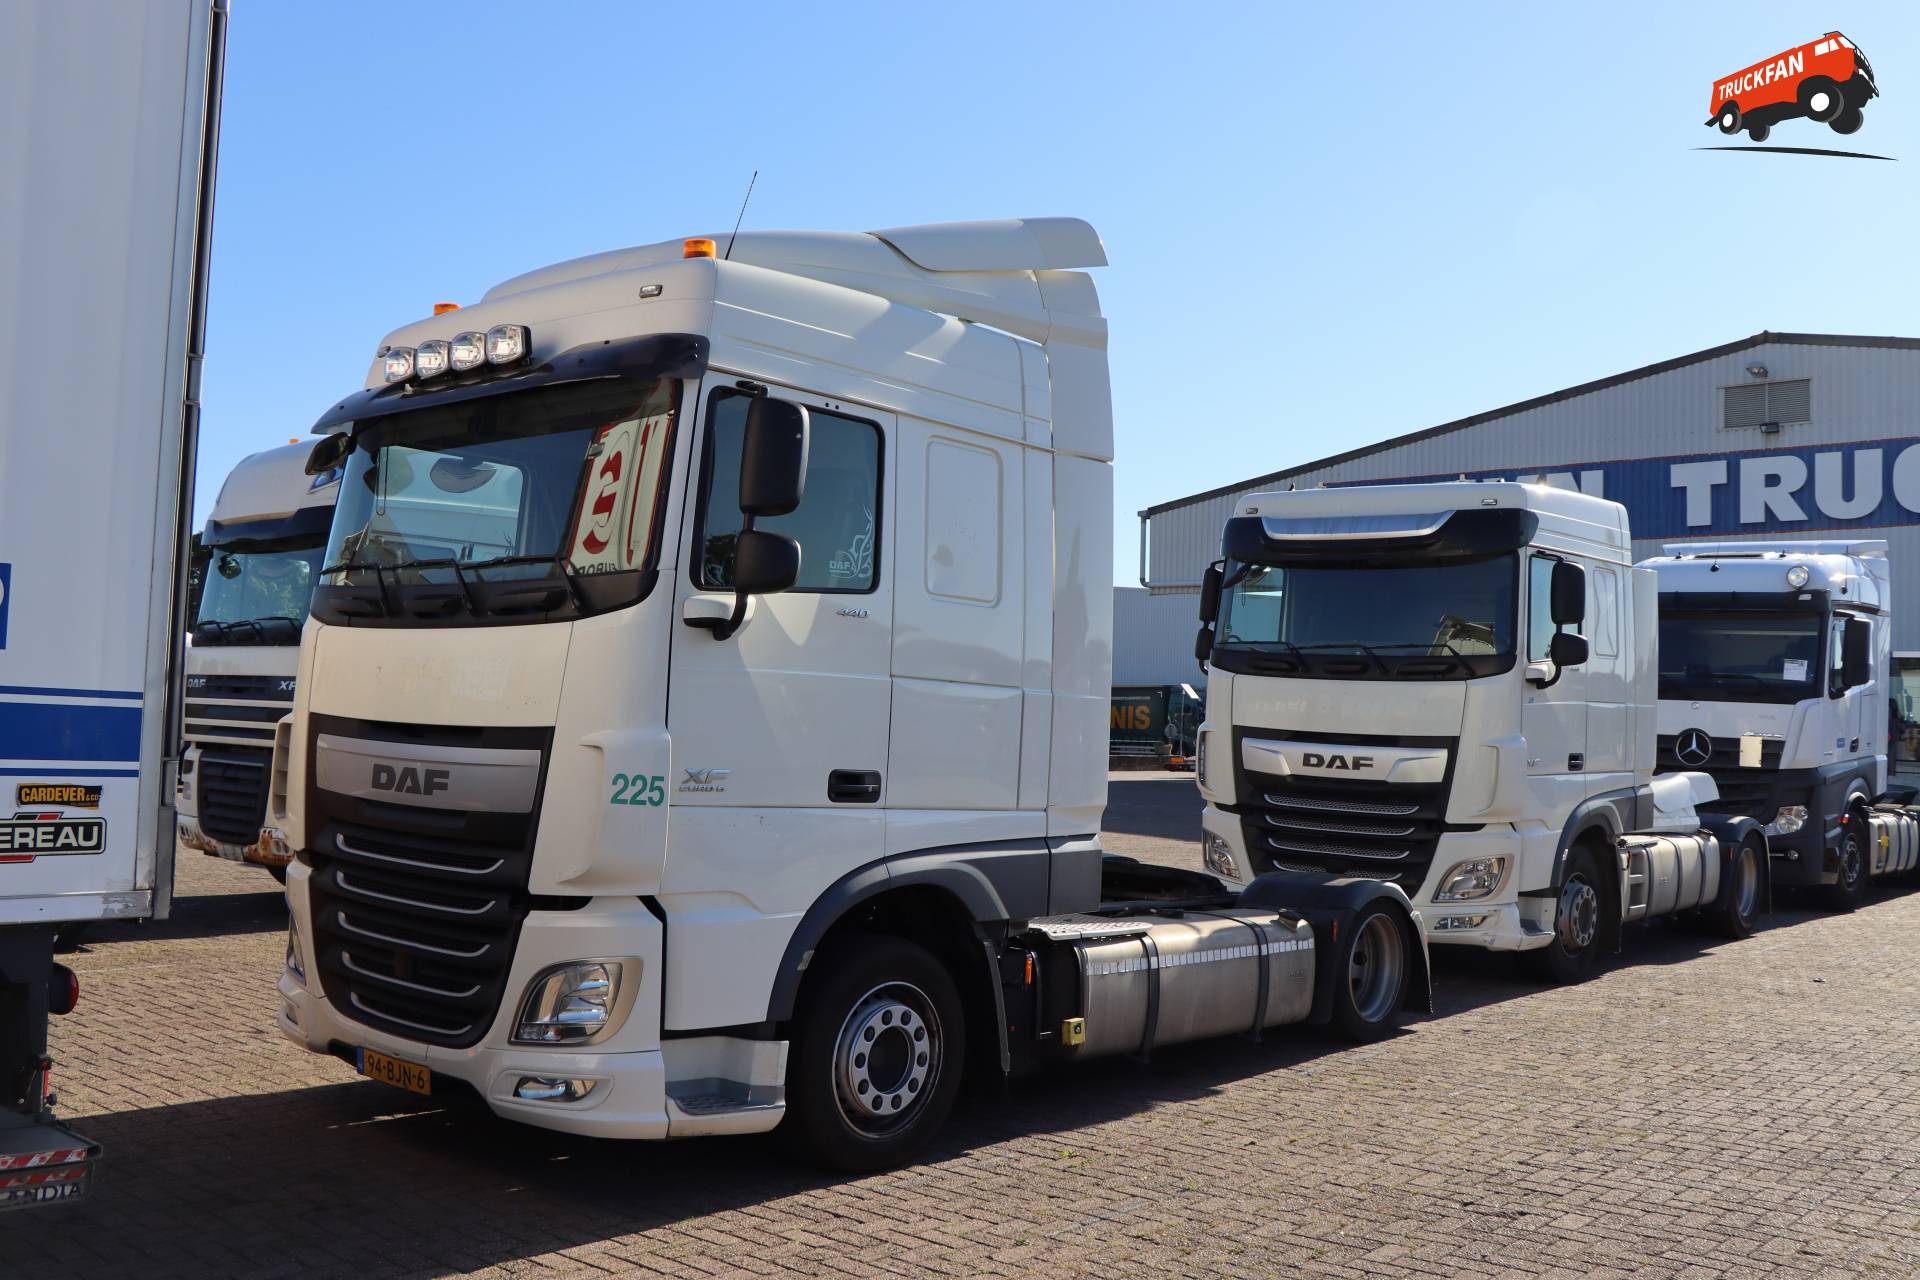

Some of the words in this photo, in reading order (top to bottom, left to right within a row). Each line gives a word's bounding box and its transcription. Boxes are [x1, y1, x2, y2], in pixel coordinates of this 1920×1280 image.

[829, 560, 850, 570] DAF
[1302, 752, 1374, 771] DAF
[371, 763, 450, 796] DAF
[610, 773, 665, 807] 225
[21, 787, 86, 802] CARDEVER
[0, 826, 99, 849] EREAU
[367, 1054, 425, 1089] 94-BJN-6
